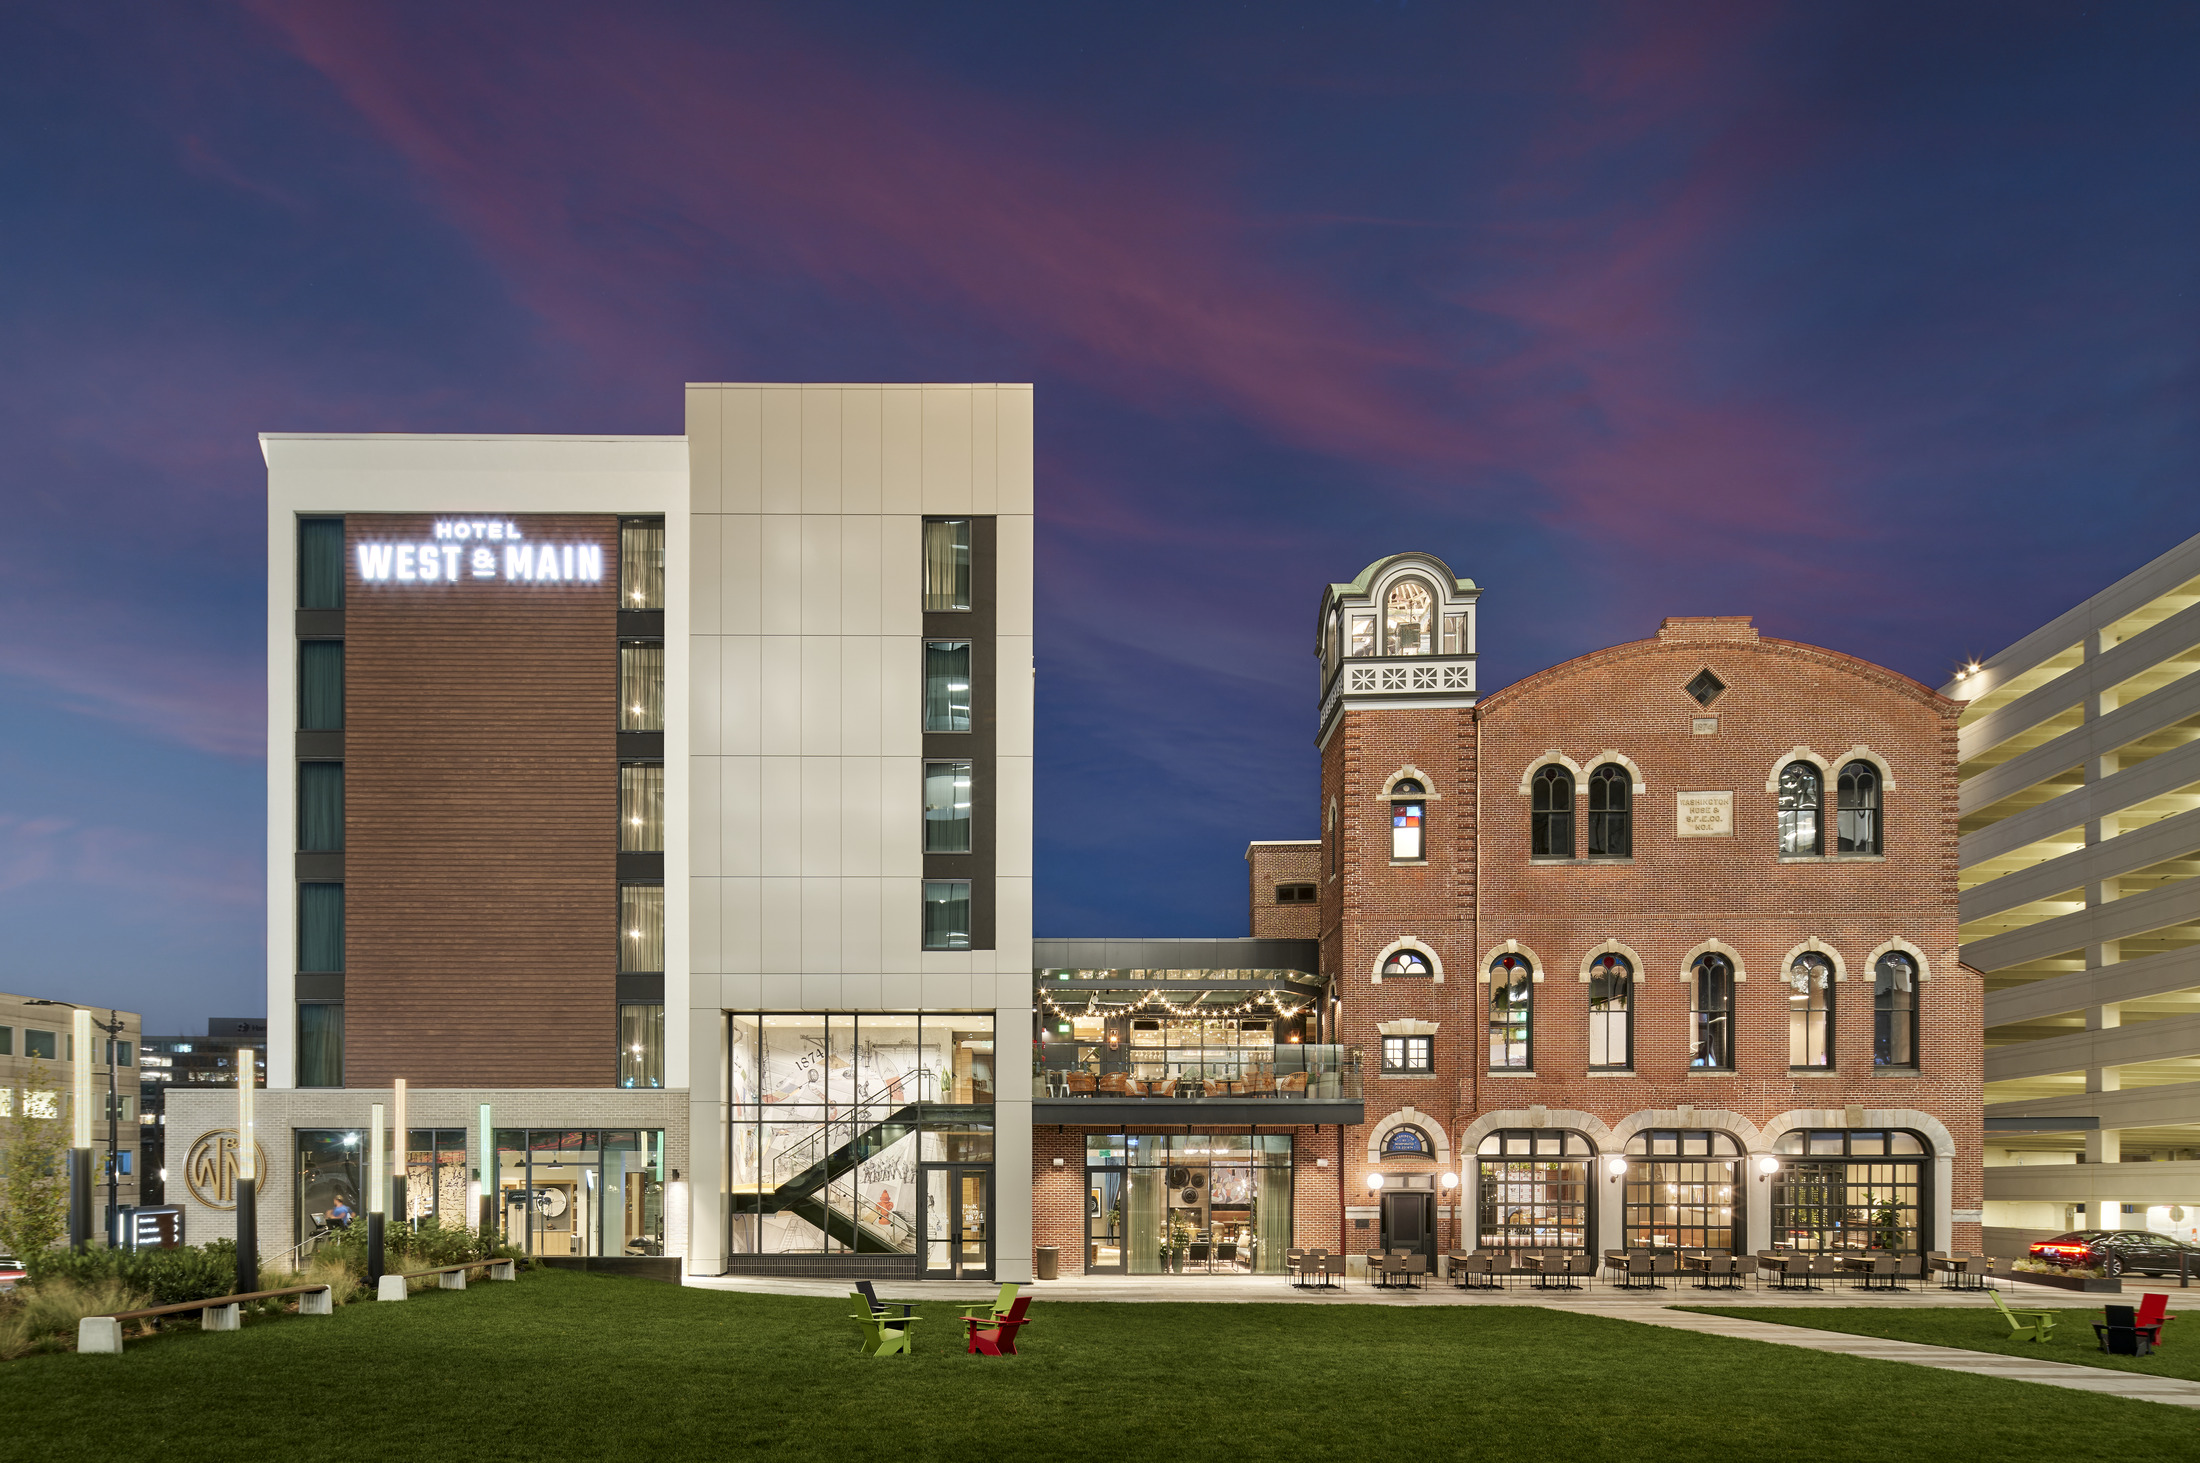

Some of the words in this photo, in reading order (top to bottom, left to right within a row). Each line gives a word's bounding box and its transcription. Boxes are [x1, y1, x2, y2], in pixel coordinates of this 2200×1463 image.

[436, 522, 522, 539] HOTEL
[357, 545, 461, 580] WEST
[472, 548, 496, 576] &
[505, 545, 600, 580] MAIN
[795, 1049, 824, 1071] 1874
